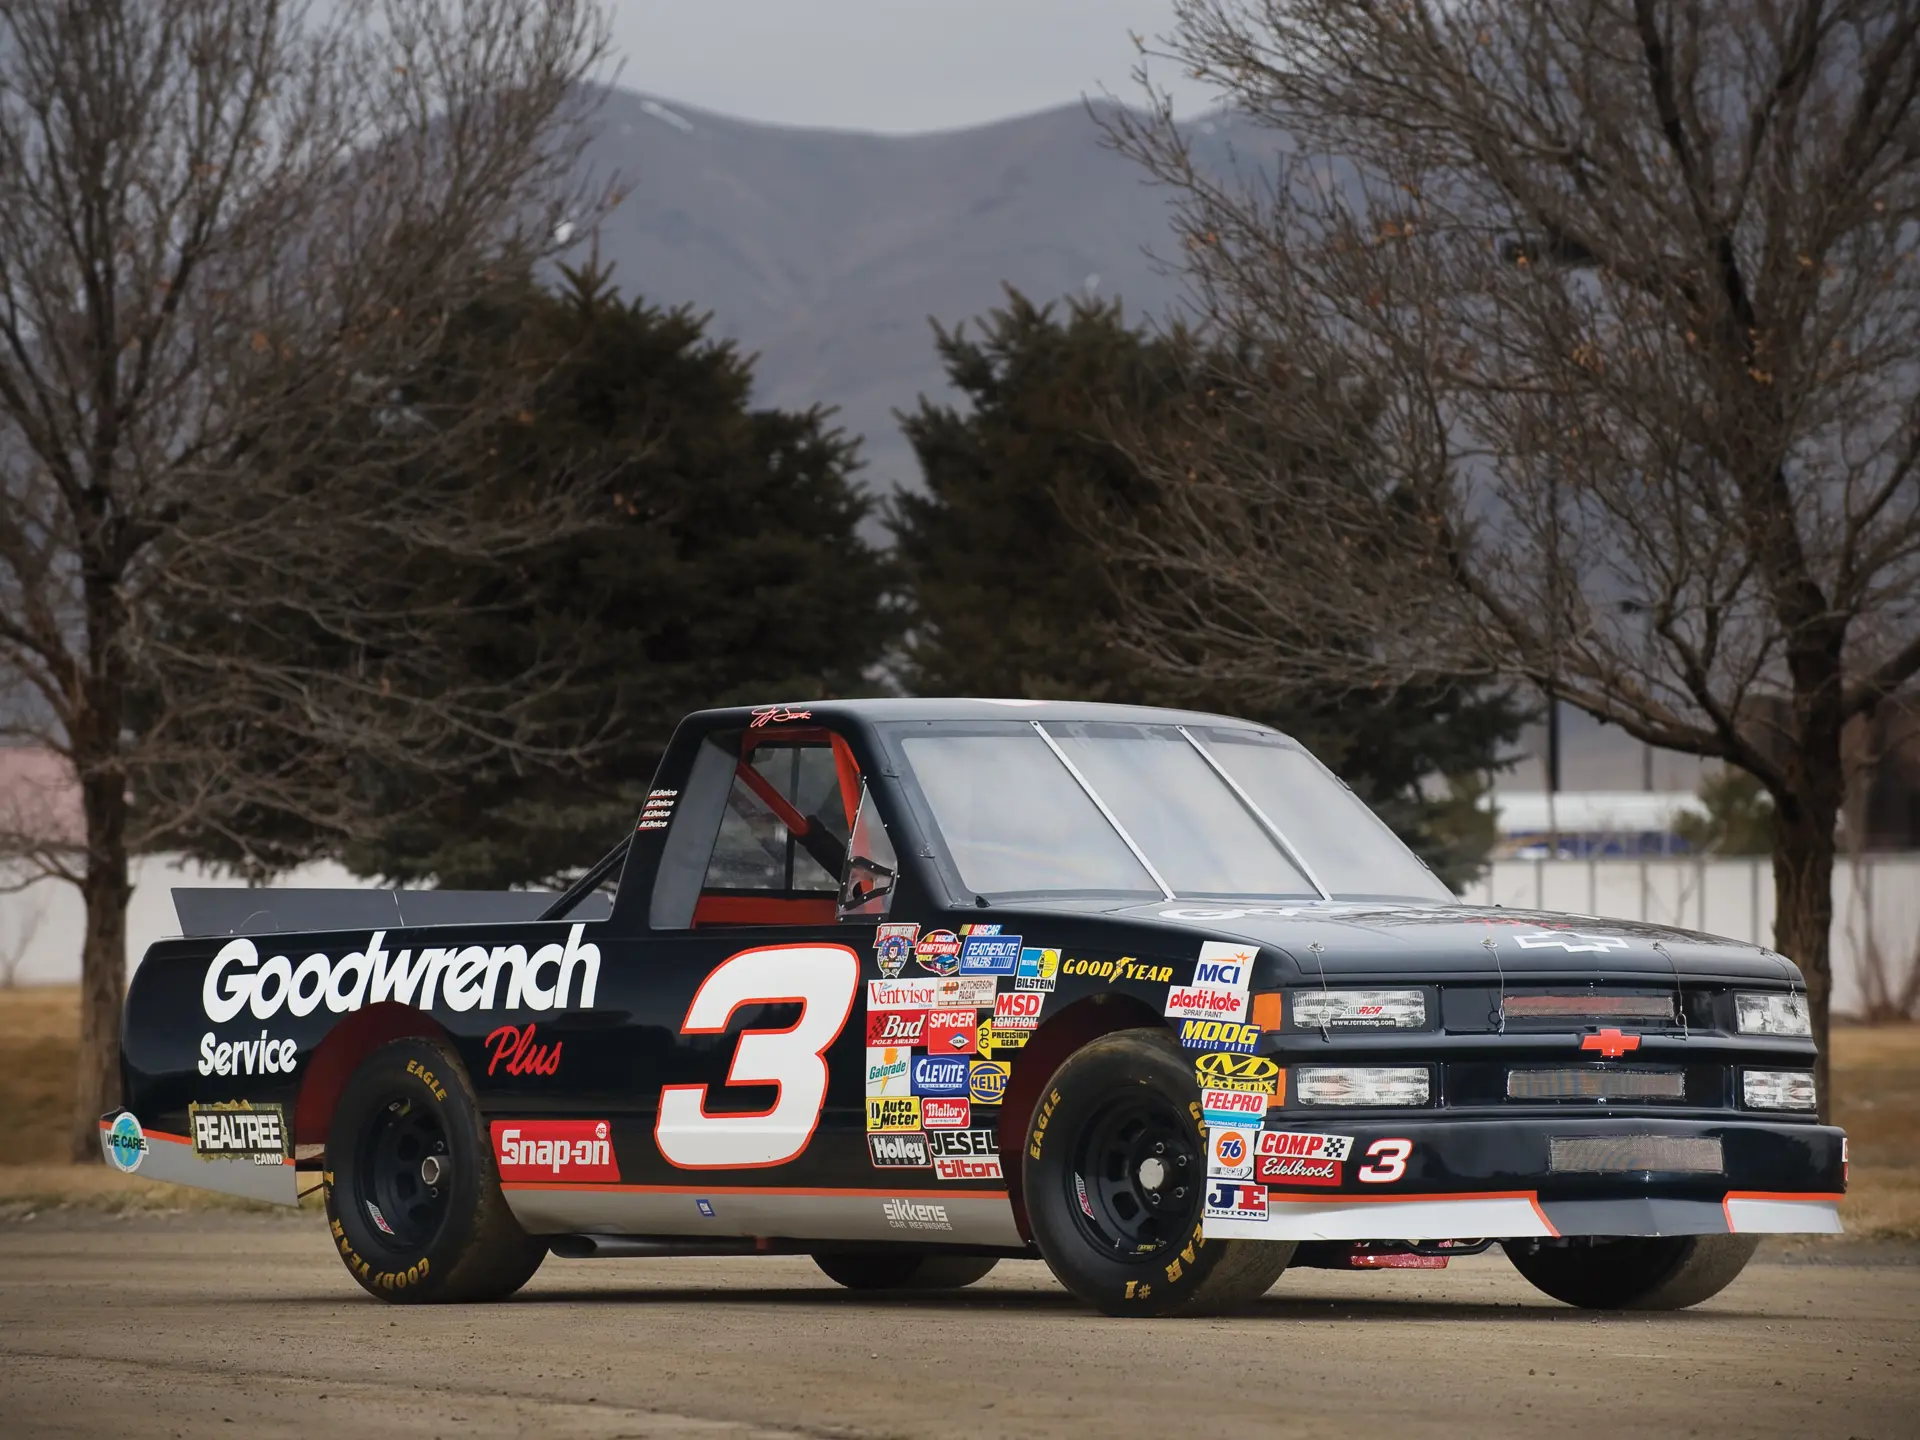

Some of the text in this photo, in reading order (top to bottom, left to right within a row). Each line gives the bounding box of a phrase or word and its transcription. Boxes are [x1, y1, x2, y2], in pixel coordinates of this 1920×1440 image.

[974, 924, 1001, 935] NASCAR
[918, 943, 957, 954] CRAFTSMAN
[966, 943, 1018, 956] FEATHERLITE
[202, 923, 600, 1023] Goodwrench
[1197, 964, 1240, 984] MCI
[870, 981, 934, 1005] Ventvisor
[1016, 978, 1055, 990] BILSTEIN
[995, 994, 1040, 1016] MSD
[1169, 989, 1241, 1012] plasti-kote
[1358, 1006, 1383, 1015] RCR
[929, 1012, 975, 1028] SPICER
[993, 1017, 1038, 1028] IGNITION
[1183, 1009, 1203, 1017] SPRAY
[1331, 1019, 1395, 1028] www.rcrracing.com
[881, 1014, 926, 1038] Bud
[992, 1031, 1028, 1039] PRECISION
[1180, 1020, 1260, 1045] MOOG
[485, 1023, 563, 1076] Plus
[893, 1037, 920, 1045] AWARD
[1182, 1039, 1255, 1053] CHASSIS PARTS
[198, 1030, 297, 1076] Service
[654, 942, 861, 1170] 3
[406, 1059, 448, 1102] EAGLE
[869, 1060, 906, 1080] Gatorade
[915, 1058, 965, 1083] CLEVITE
[1195, 1070, 1276, 1095] Mechanix
[883, 1100, 912, 1112] Auto
[926, 1103, 967, 1119] Mallory
[881, 1112, 918, 1126] Meter
[1030, 1088, 1061, 1160] EAGLE
[106, 1134, 120, 1147] WE
[194, 1115, 282, 1149] REALTREE
[501, 1129, 610, 1173] Snap-on
[873, 1137, 926, 1165] Holley
[930, 1131, 999, 1155] JESEL
[1220, 1140, 1243, 1158] 76
[1261, 1133, 1325, 1156] COMP
[254, 1153, 283, 1165] CAMO
[937, 1160, 1000, 1178] tilton
[1262, 1157, 1335, 1179] Edelbrock
[1358, 1137, 1413, 1183] 3
[1207, 1183, 1266, 1209] JE
[883, 1199, 949, 1222] sikkens
[1207, 1209, 1266, 1217] PISTONS
